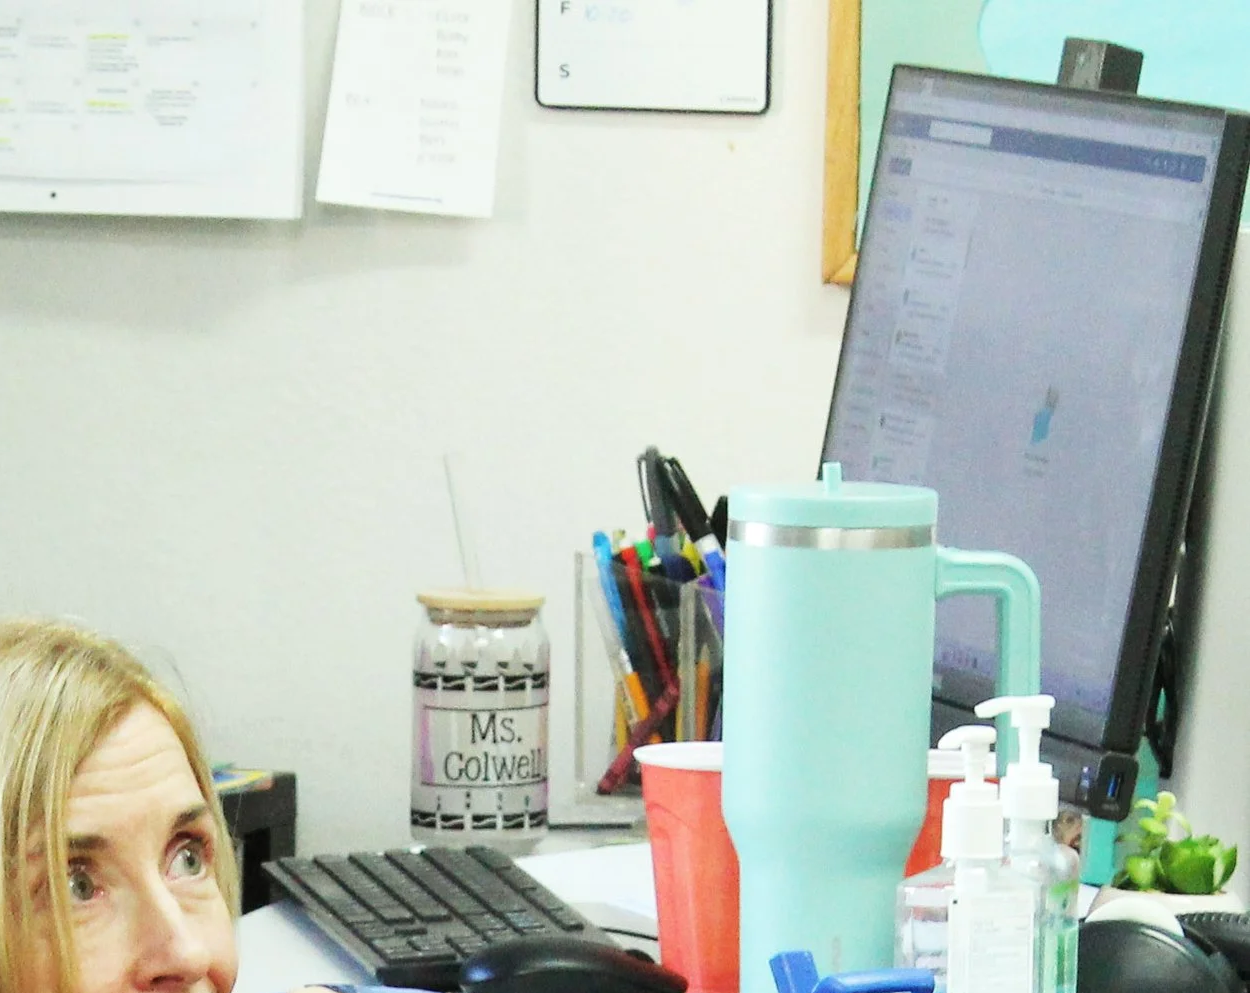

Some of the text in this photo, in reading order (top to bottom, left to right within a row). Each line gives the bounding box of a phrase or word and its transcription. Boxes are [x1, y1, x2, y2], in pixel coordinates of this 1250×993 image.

[560, 1, 570, 14] F
[559, 63, 570, 78] S
[471, 713, 522, 744] Ms.
